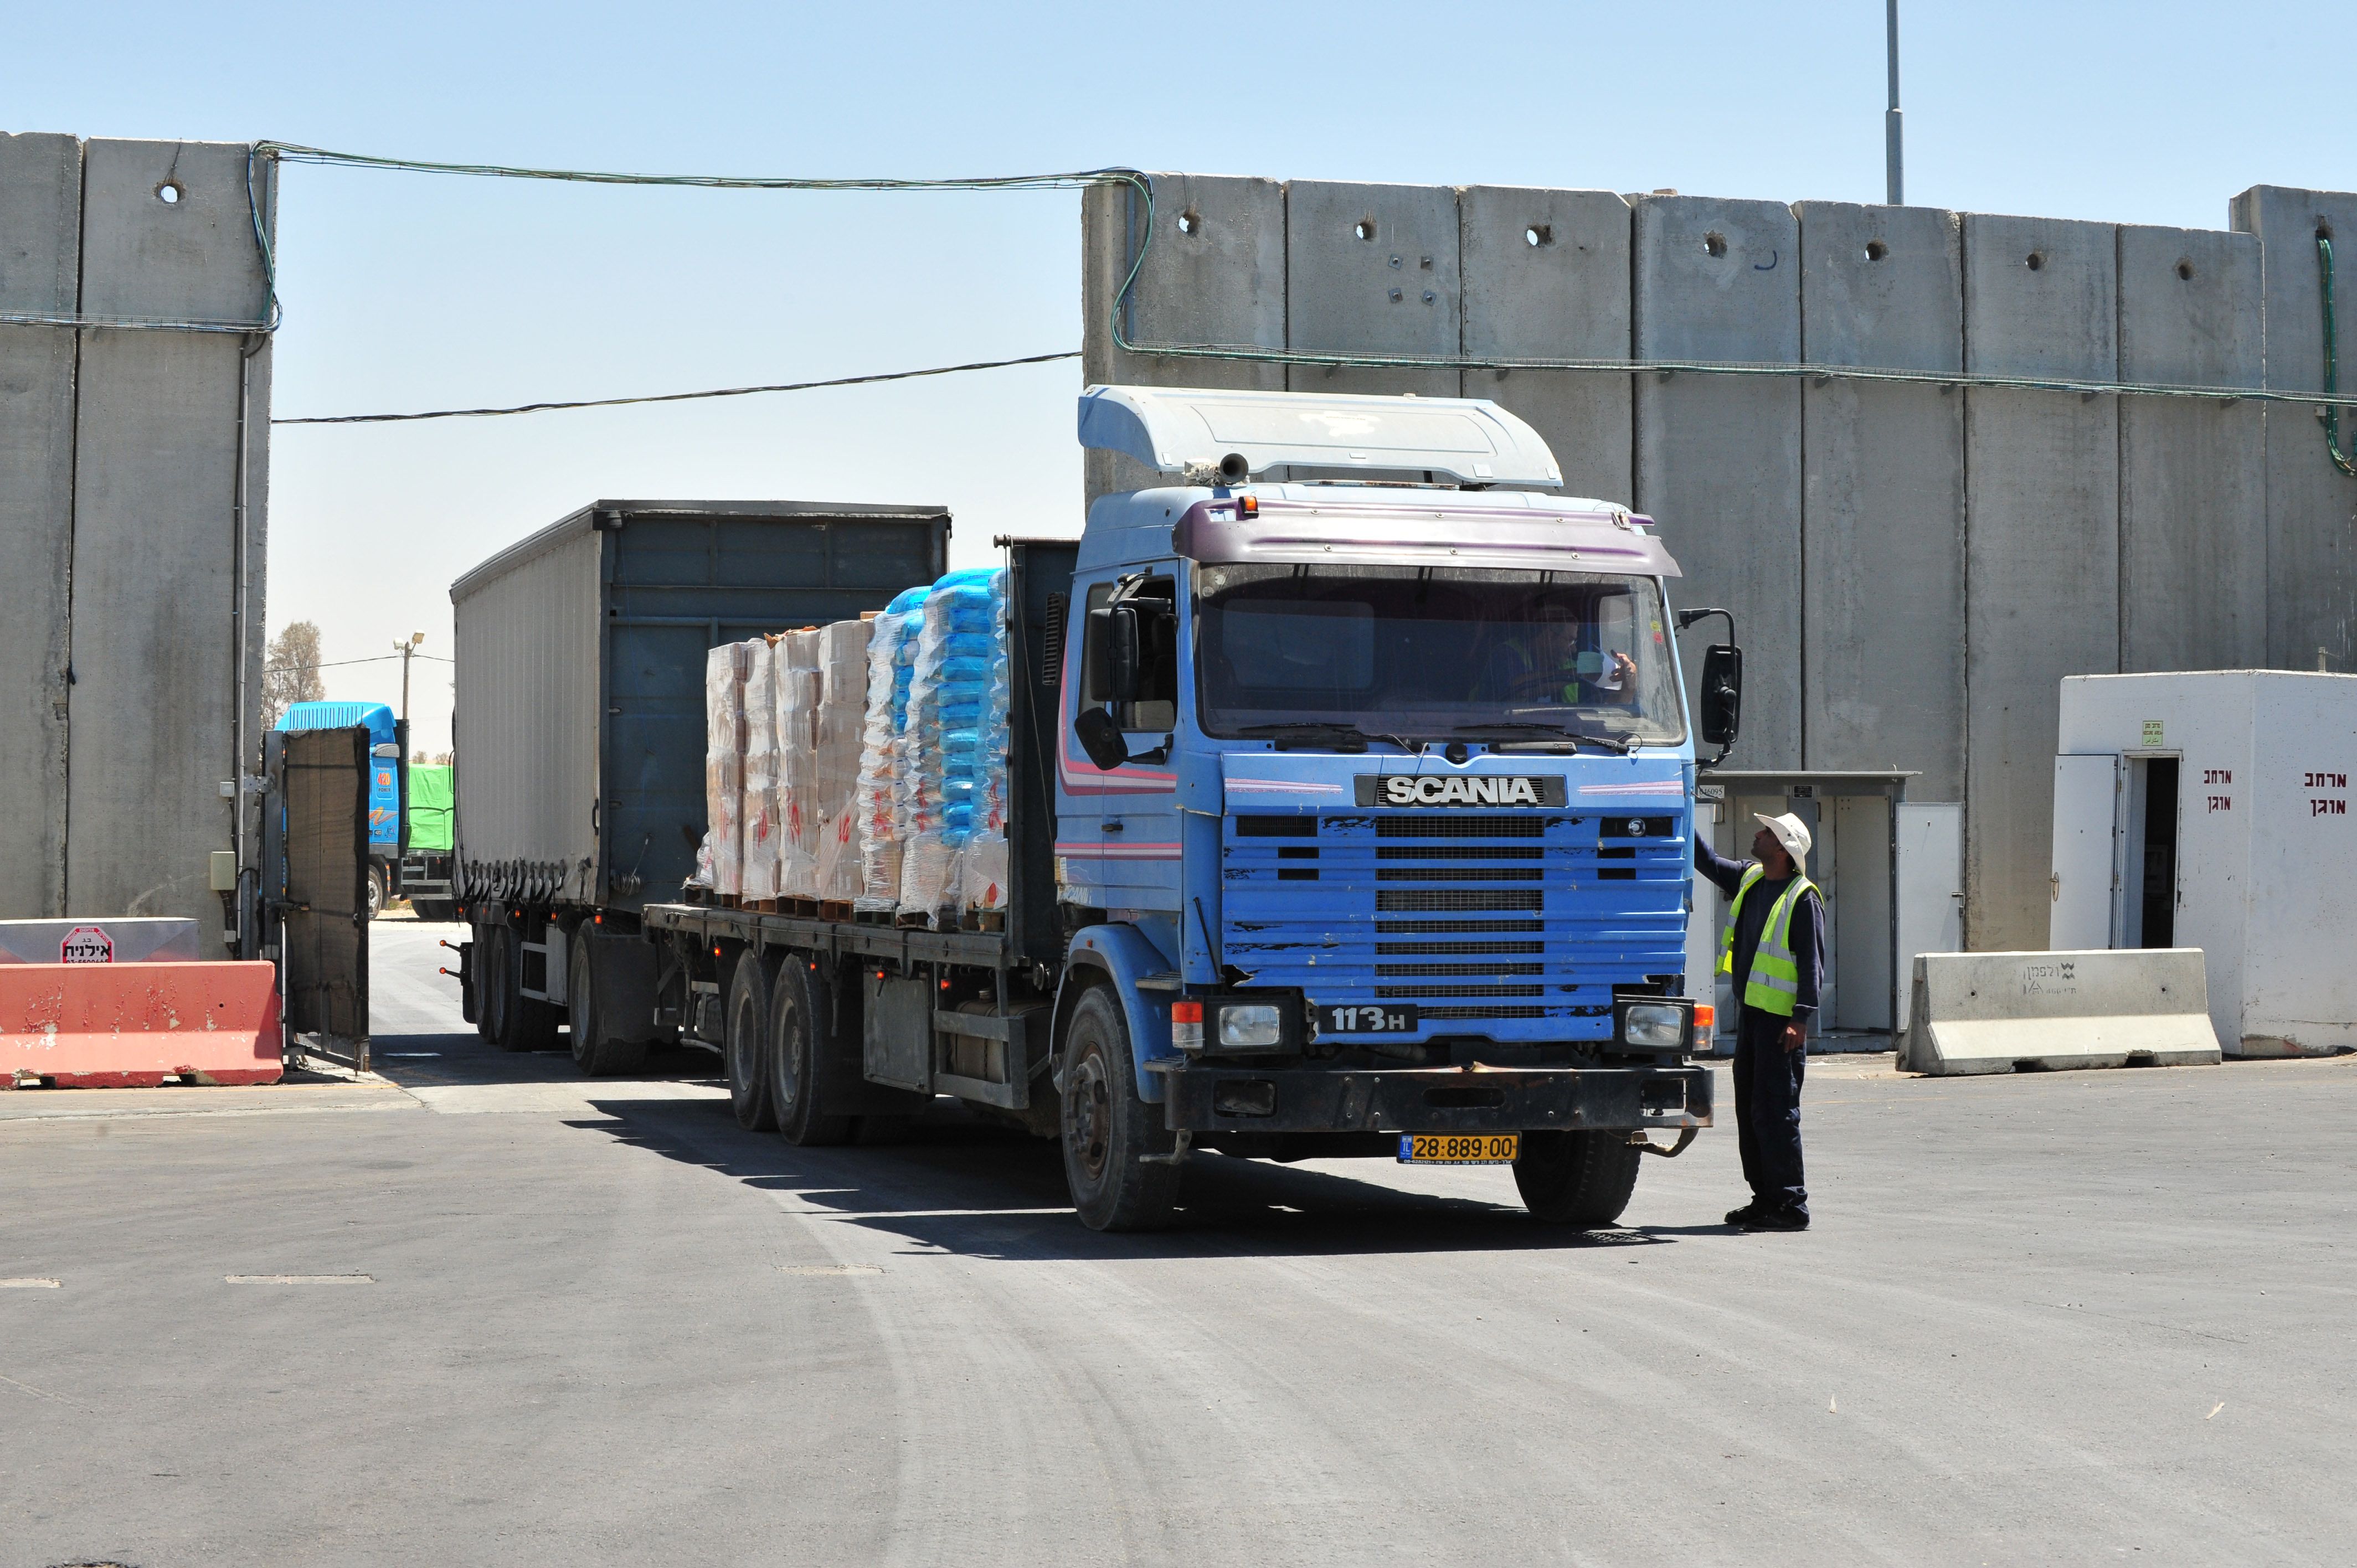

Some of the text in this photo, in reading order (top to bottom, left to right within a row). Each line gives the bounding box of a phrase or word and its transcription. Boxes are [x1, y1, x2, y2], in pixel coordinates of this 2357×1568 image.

[378, 772, 390, 785] 420
[1387, 777, 1538, 803] SCANIA
[63, 945, 111, 956] אילנית
[1403, 1142, 1411, 1152] IL
